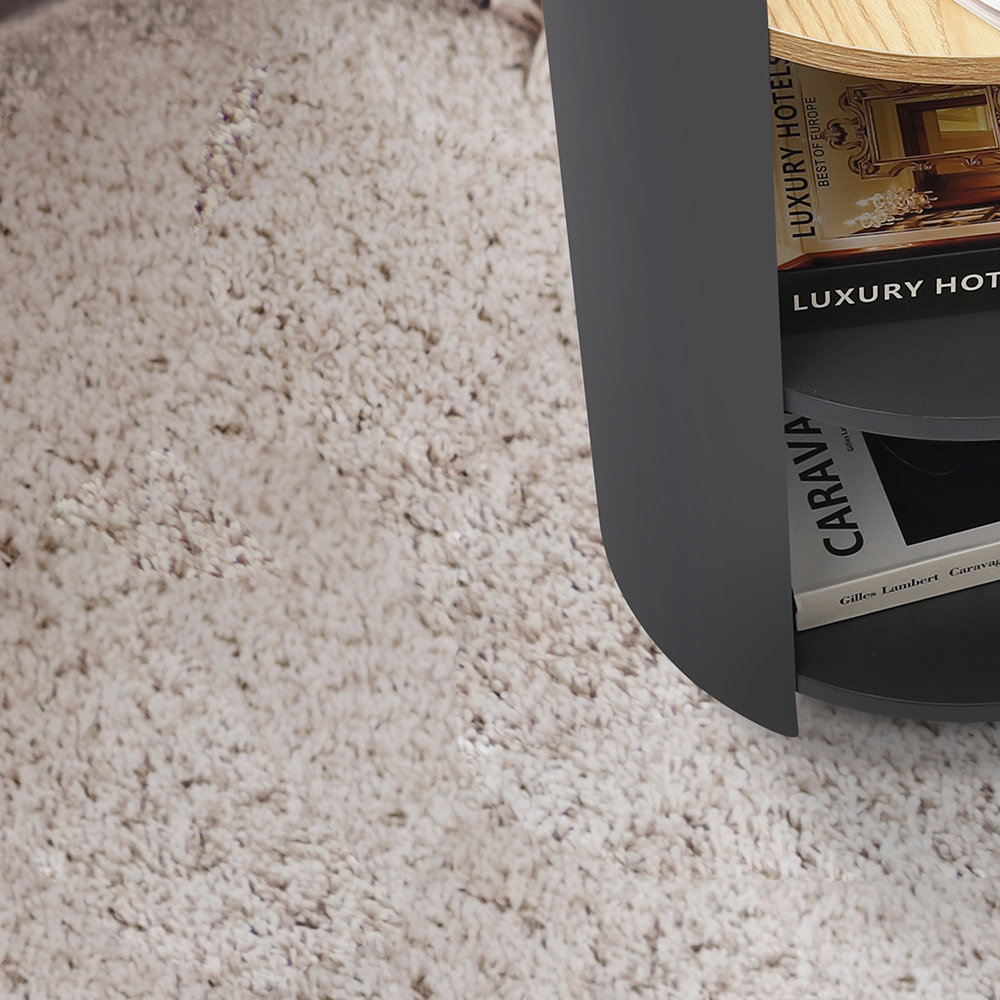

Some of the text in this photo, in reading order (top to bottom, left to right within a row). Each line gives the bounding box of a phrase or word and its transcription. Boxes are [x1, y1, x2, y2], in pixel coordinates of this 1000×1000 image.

[804, 96, 830, 187] BEST OF EUROPE
[779, 147, 816, 238] LUXURY
[793, 279, 925, 311] LUXURY
[783, 411, 864, 557] CARAVA
[839, 591, 877, 605] Gilles
[881, 574, 940, 594] Lambert
